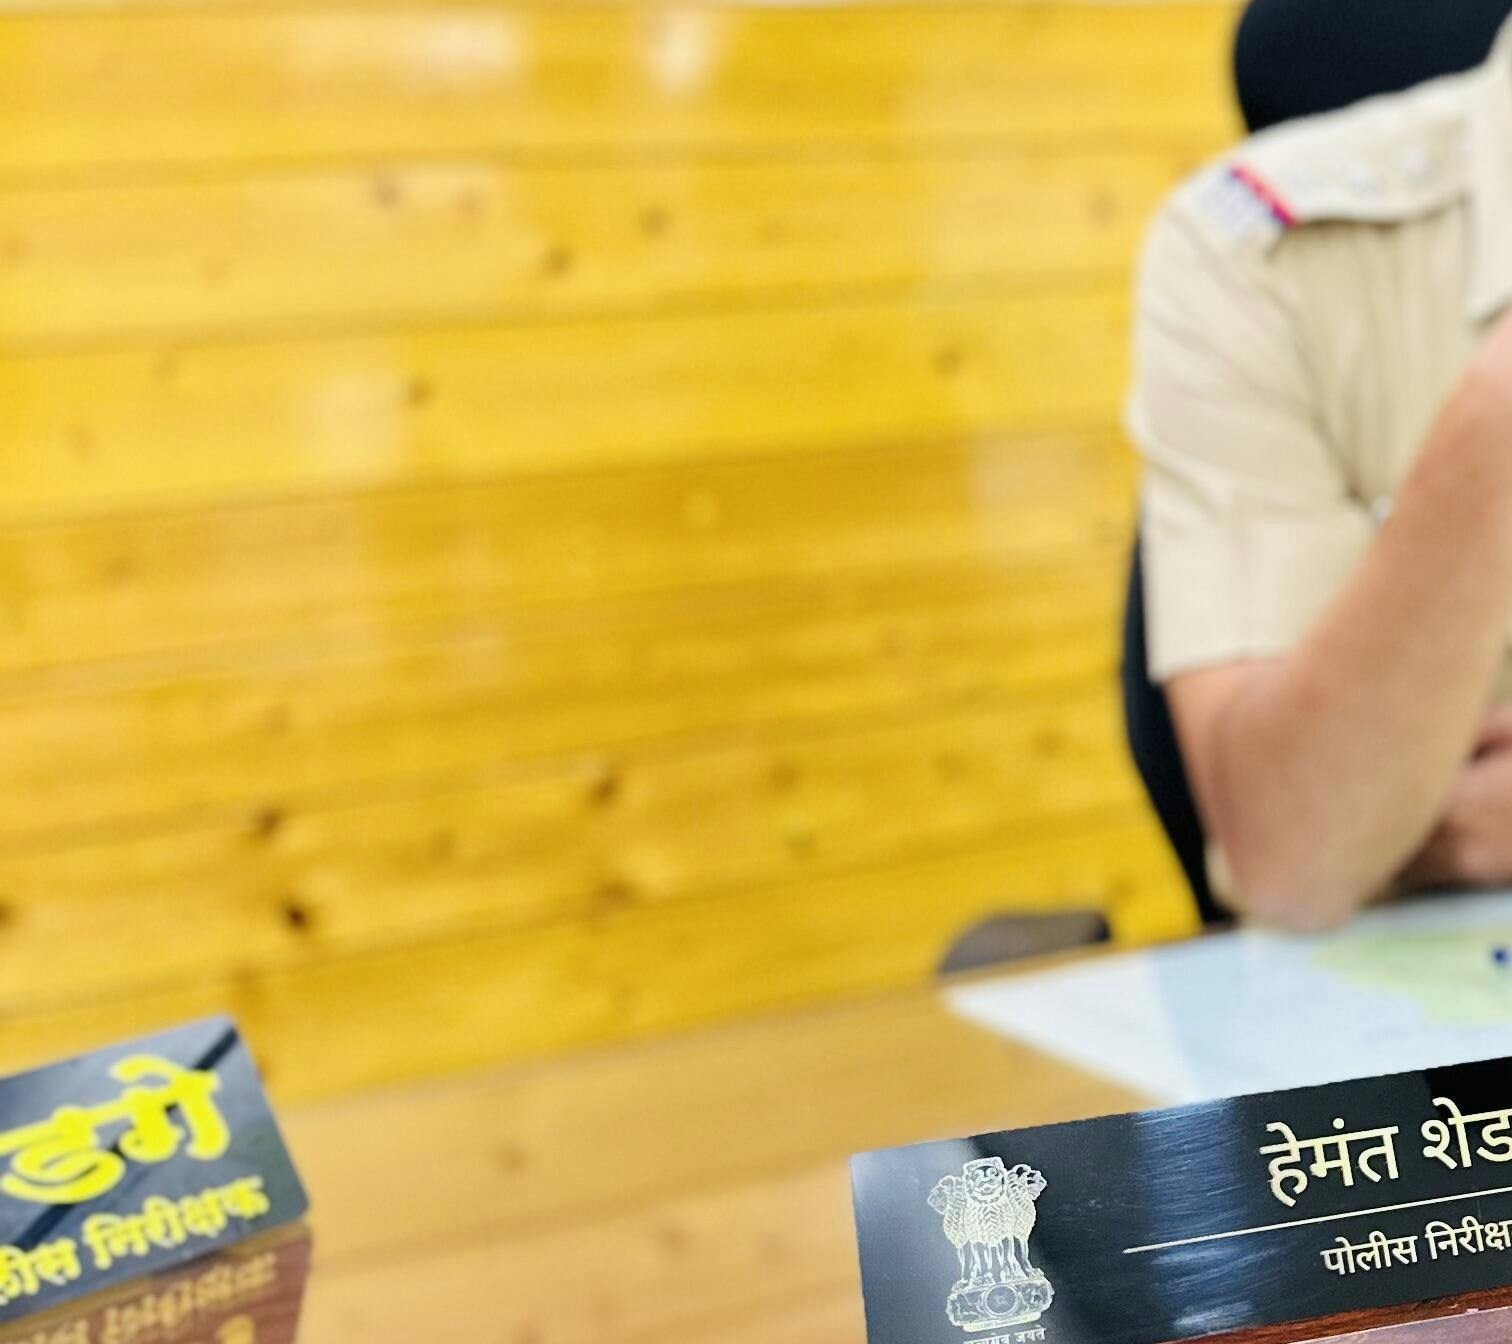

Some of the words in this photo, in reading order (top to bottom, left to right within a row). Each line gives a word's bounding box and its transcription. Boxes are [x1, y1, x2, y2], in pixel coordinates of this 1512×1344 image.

[0, 1054, 230, 1204] डगे
[1259, 1117, 1399, 1207] हेमंत
[1319, 1230, 1418, 1276] पोलीस
